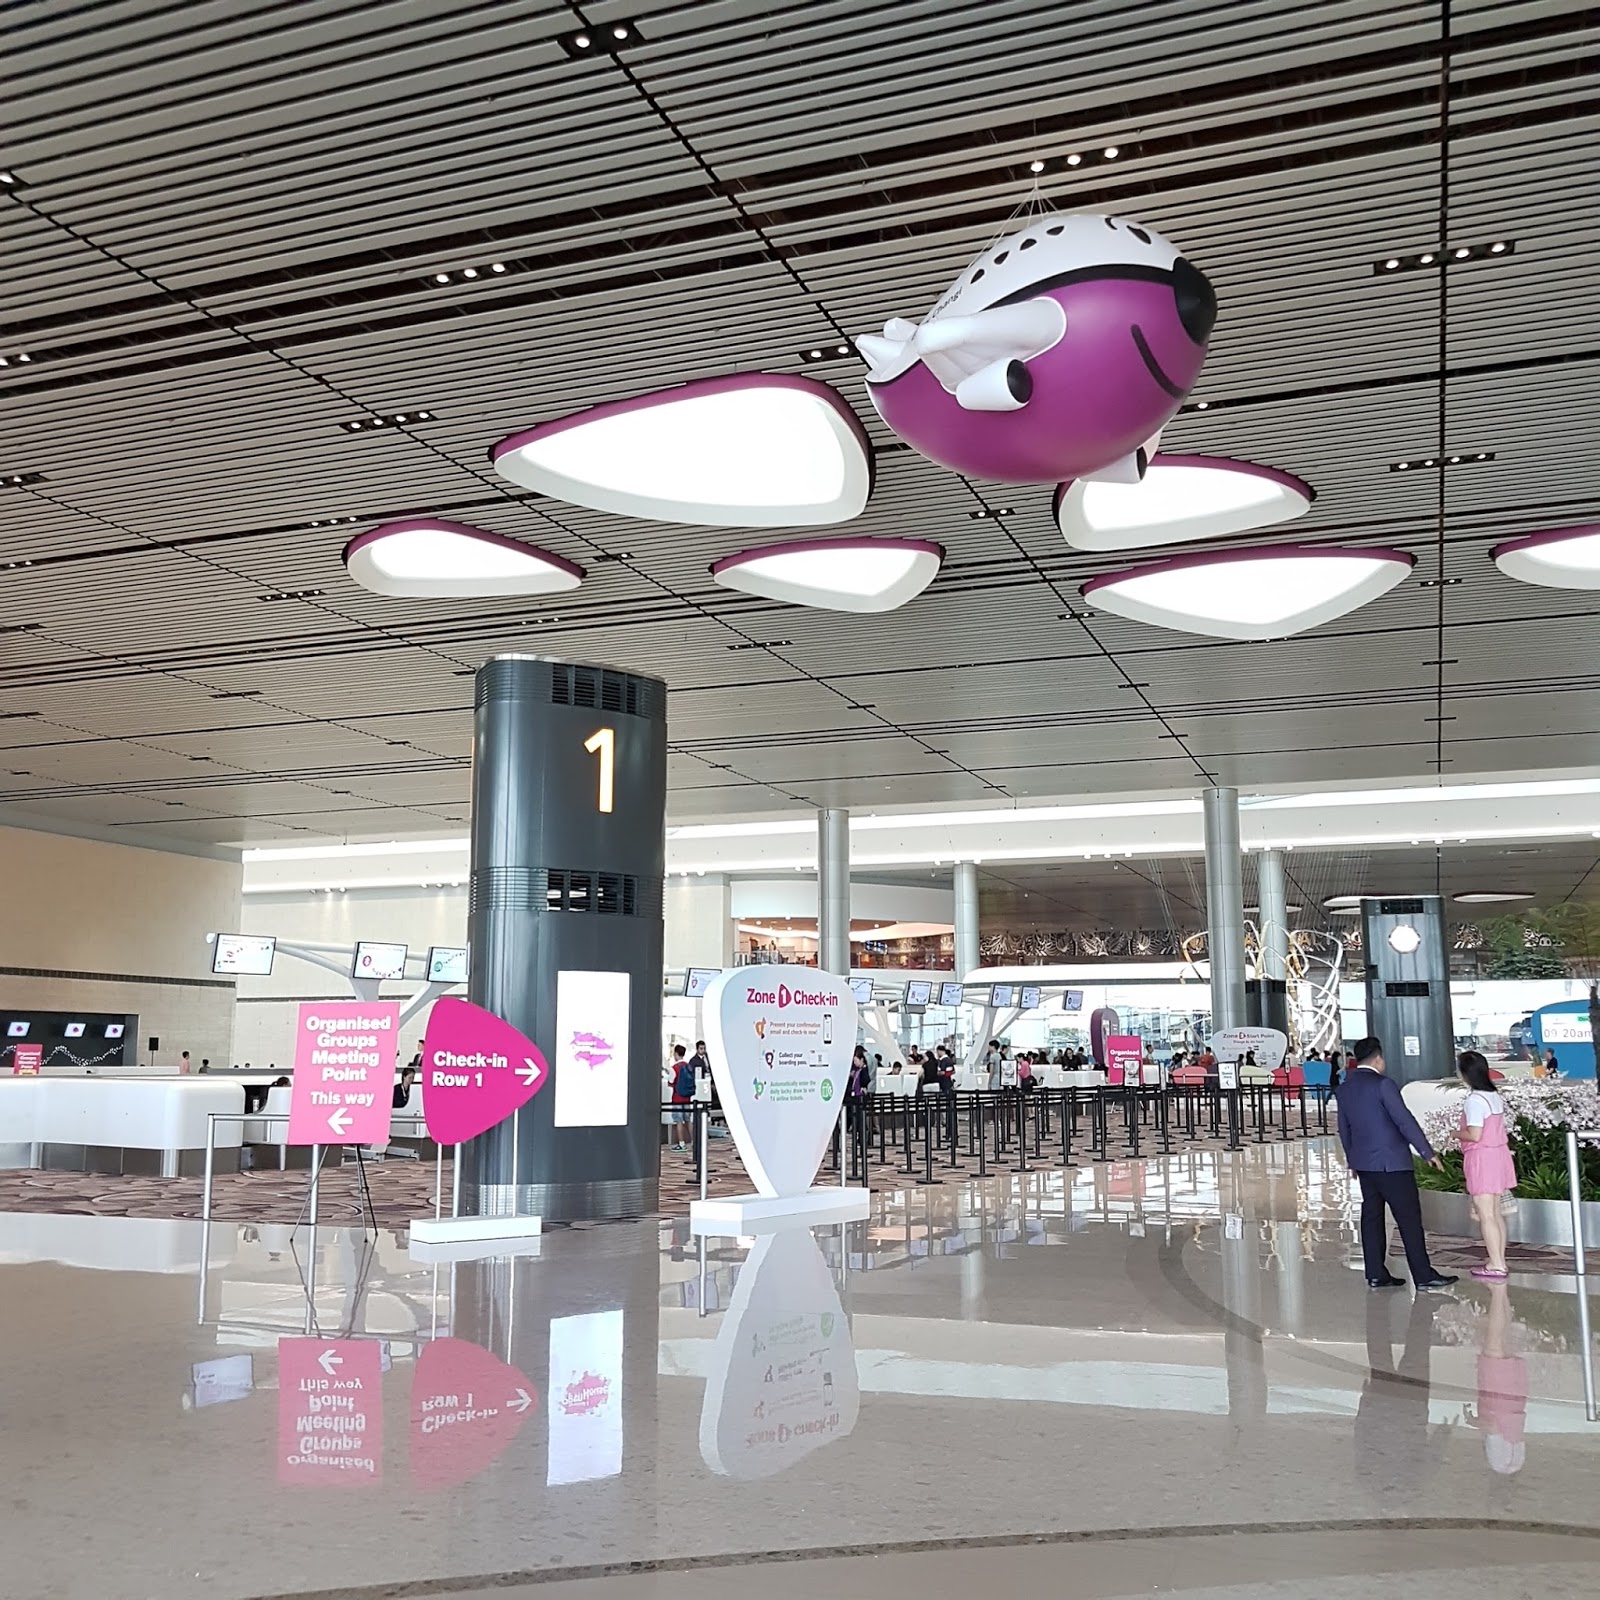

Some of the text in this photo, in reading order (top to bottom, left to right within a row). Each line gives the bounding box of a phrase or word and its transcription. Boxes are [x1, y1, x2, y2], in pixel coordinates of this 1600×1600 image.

[584, 728, 614, 813] 1
[747, 988, 776, 1004] Zone
[794, 990, 838, 1006] Check-in
[306, 1016, 391, 1034] Organised
[317, 1035, 378, 1050] Groups
[312, 1051, 380, 1067] Meeting
[433, 1051, 508, 1068] Check-in
[322, 1067, 367, 1082] Point
[432, 1072, 483, 1087] Row 1
[310, 1091, 374, 1107] This way
